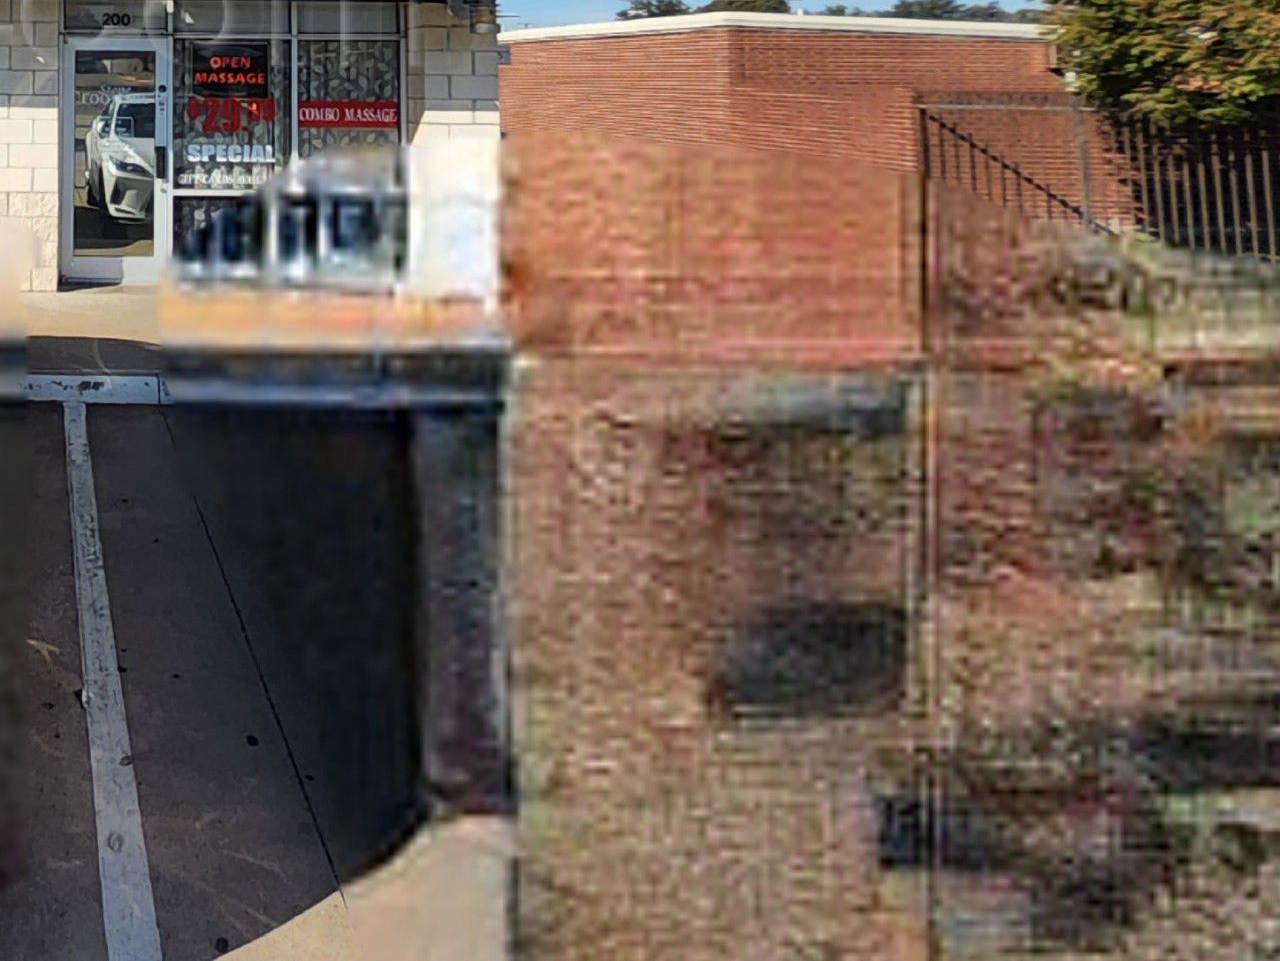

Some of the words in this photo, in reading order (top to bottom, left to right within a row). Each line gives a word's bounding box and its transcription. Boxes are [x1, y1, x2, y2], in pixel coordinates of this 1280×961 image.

[102, 13, 131, 26] 200
[209, 56, 251, 69] OPEN
[195, 72, 265, 84] MASSAGE
[299, 107, 340, 122] COMBO
[344, 108, 398, 122] MASSAGE
[187, 144, 276, 163] SPECIAL
